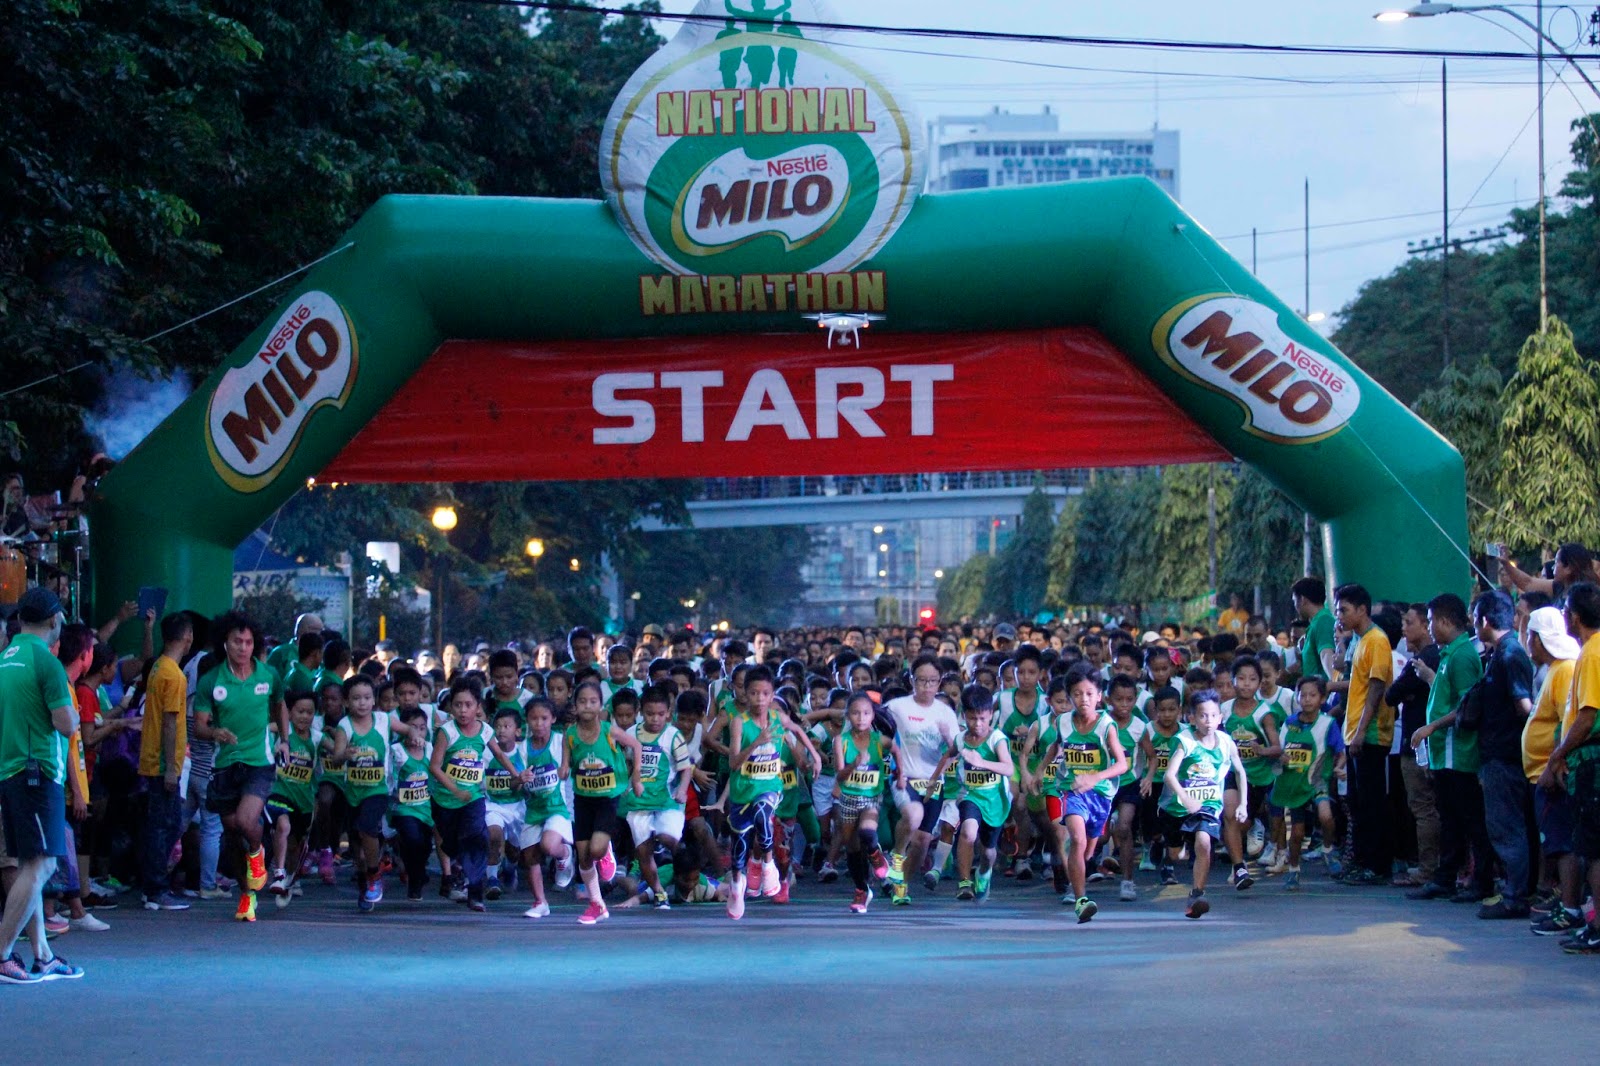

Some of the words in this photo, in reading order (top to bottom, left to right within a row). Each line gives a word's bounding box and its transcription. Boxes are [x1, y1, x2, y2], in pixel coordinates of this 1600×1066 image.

[656, 87, 876, 137] NATIONAL
[695, 174, 834, 230] MILO
[639, 271, 887, 316] MARATHON
[1181, 310, 1333, 425] MILO
[221, 317, 342, 464] MILO
[592, 364, 954, 445] START
[641, 754, 658, 765] 5921
[350, 769, 381, 781] 41286
[449, 767, 480, 781] 41288
[850, 773, 874, 783] 1604
[966, 772, 996, 784] 40919
[581, 775, 611, 788] 41607
[1186, 788, 1216, 801] 0762
